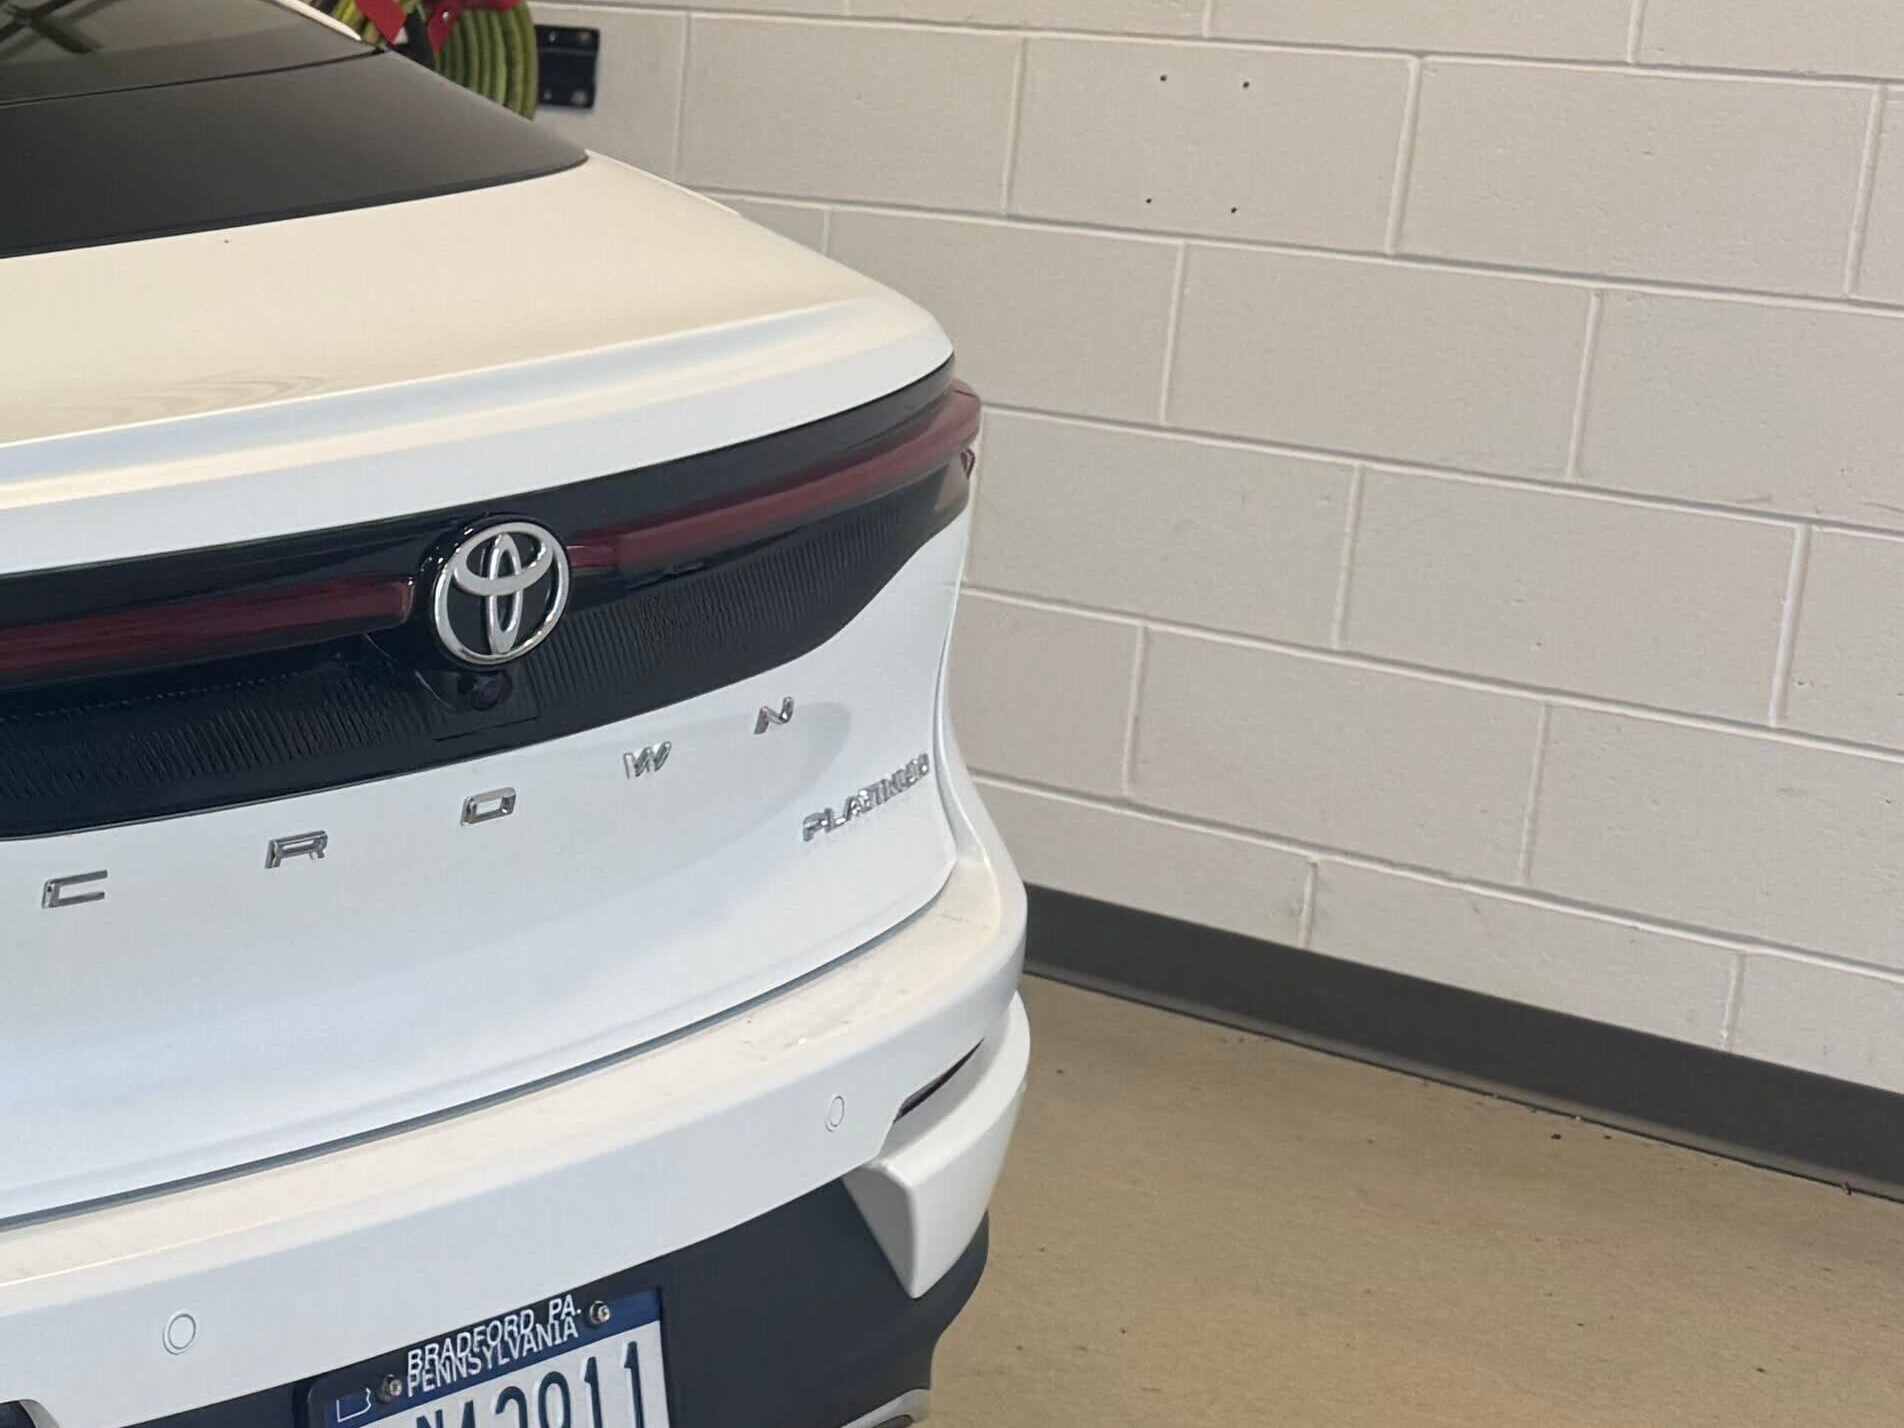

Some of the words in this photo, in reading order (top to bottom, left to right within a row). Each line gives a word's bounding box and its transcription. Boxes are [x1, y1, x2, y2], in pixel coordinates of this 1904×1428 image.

[41, 696, 794, 910] CROWN
[548, 1294, 582, 1325] PA.
[407, 1316, 579, 1397] PENNSYLVANIA
